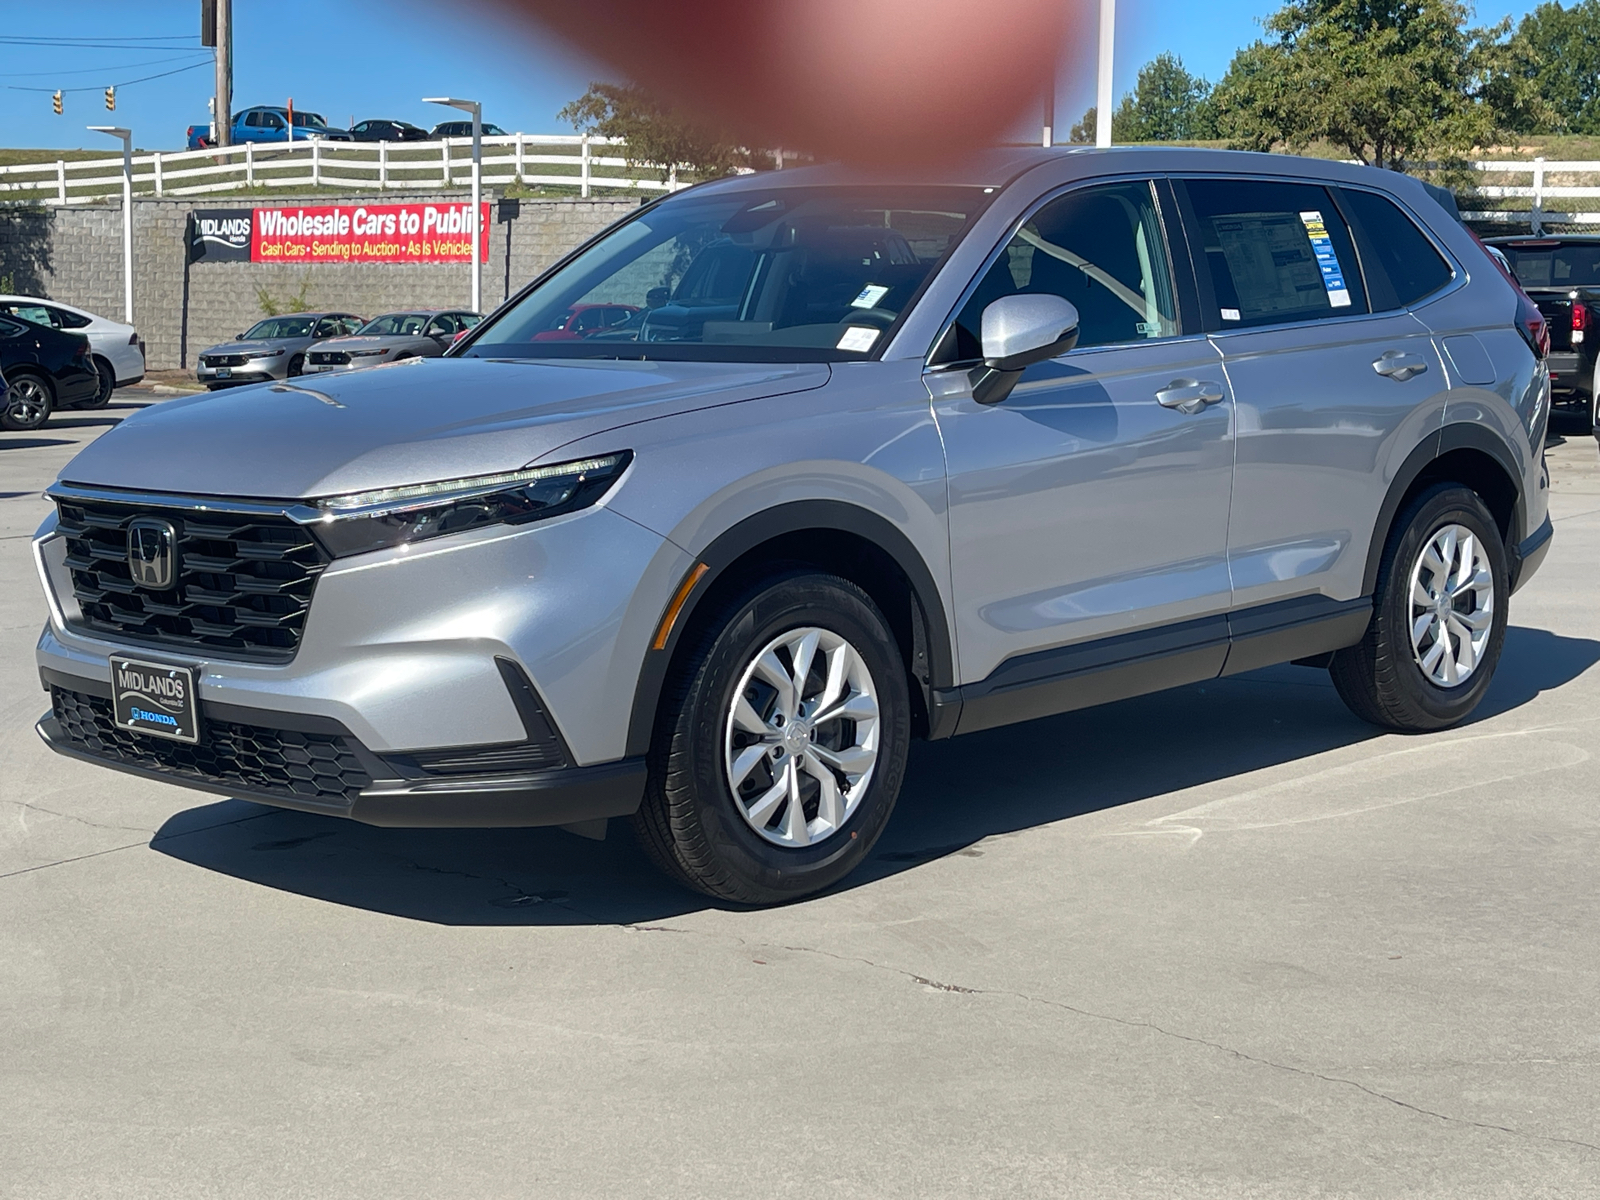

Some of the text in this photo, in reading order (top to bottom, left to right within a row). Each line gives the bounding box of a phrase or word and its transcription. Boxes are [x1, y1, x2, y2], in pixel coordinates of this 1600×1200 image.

[195, 218, 251, 235] MIDLANDS
[259, 208, 350, 236] Wholesale
[352, 207, 397, 235] Cars
[399, 208, 420, 235] to
[260, 241, 283, 256] Cash
[284, 241, 306, 256] Cars
[312, 240, 350, 259] Sending
[351, 241, 362, 256] to
[362, 240, 400, 256] Auction
[406, 239, 421, 256] As
[422, 239, 432, 256] Is
[118, 669, 184, 699] MIDLANDS
[139, 710, 178, 726] HONDA
